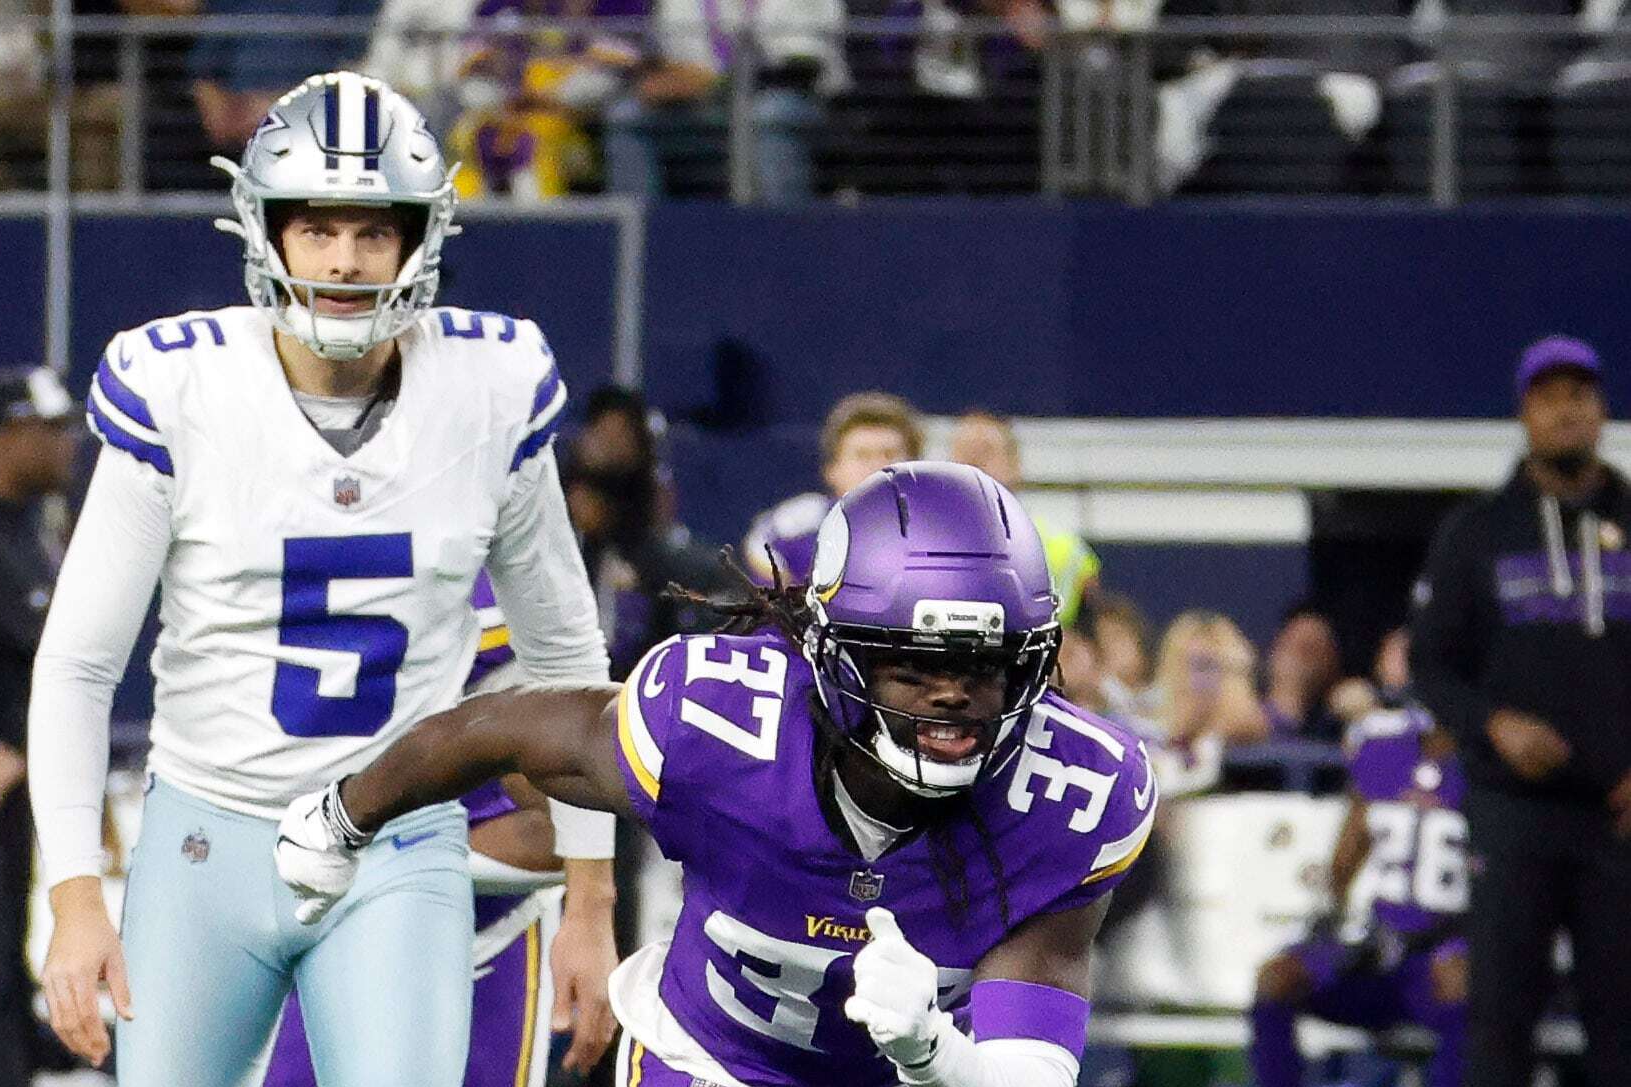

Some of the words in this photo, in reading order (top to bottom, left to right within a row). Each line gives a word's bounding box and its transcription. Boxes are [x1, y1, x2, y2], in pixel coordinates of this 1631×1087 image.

[145, 317, 226, 353] 5
[271, 532, 414, 738] 5
[680, 635, 788, 761] 37
[1007, 702, 1126, 833] 37
[1363, 803, 1471, 912] 26
